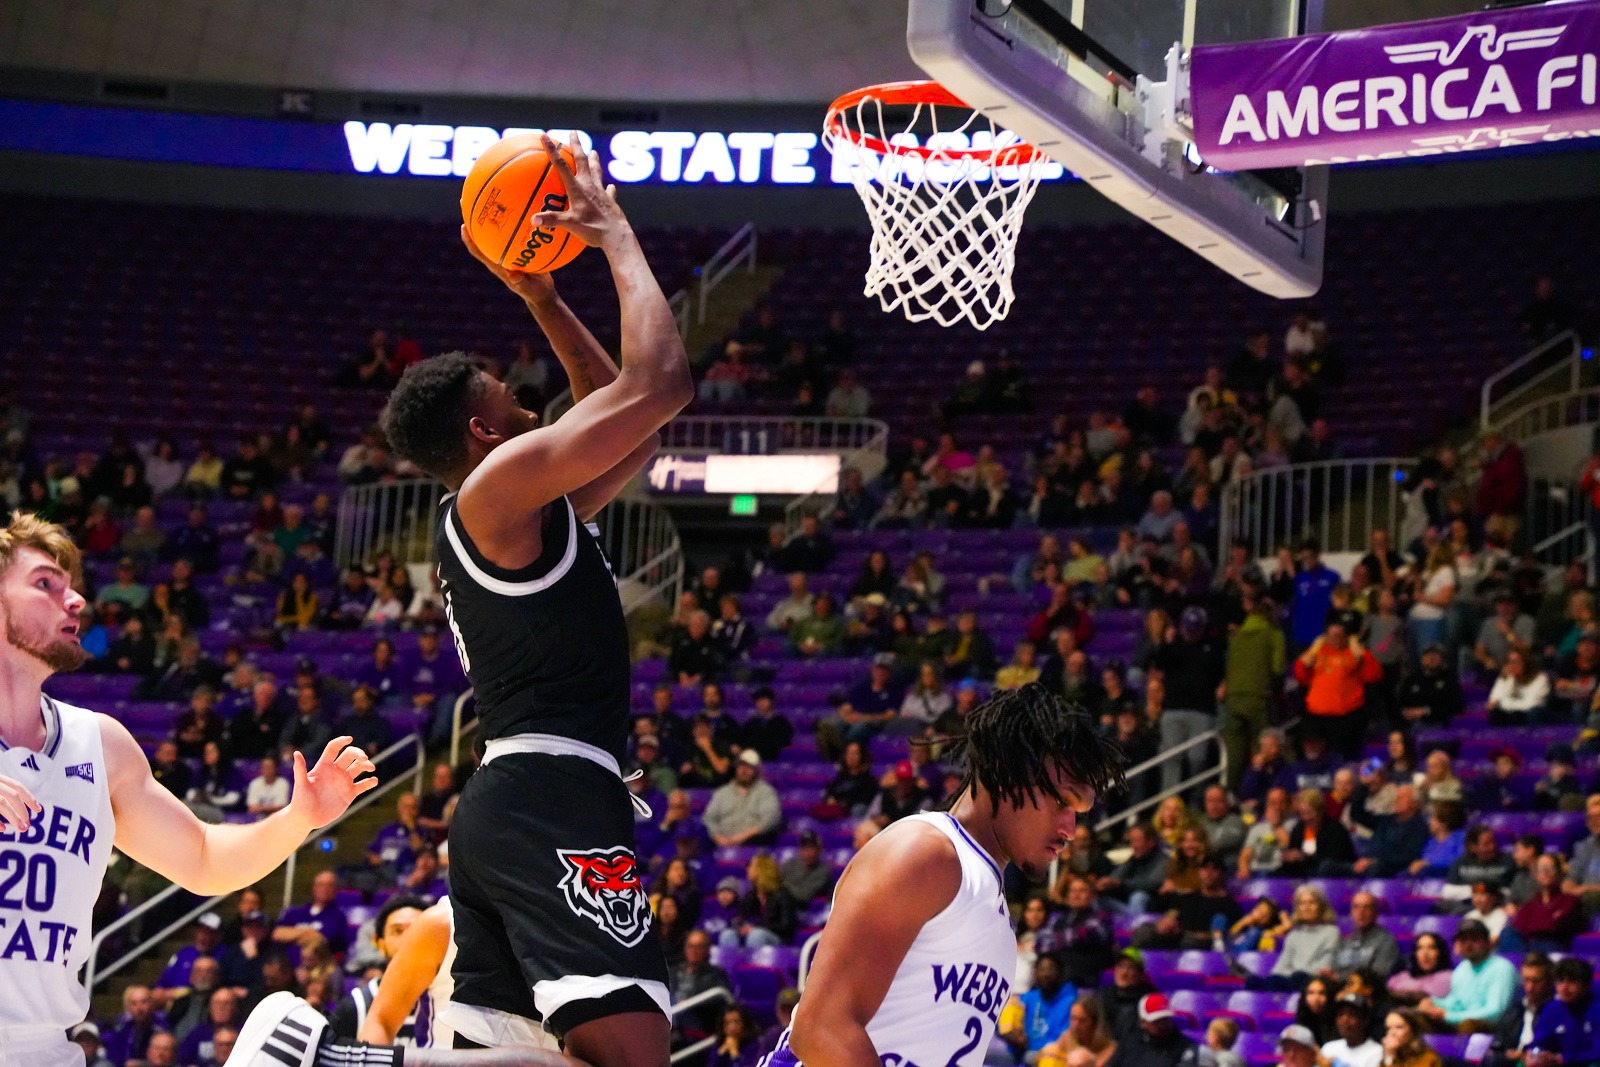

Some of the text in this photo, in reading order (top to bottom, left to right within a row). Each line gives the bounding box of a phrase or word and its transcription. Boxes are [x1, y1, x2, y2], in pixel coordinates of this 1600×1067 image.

[1218, 65, 1521, 145] AMERICA
[344, 120, 592, 177] WEB
[608, 130, 817, 183] STATE
[512, 193, 568, 268] Wlson
[0, 849, 57, 912] 20
[0, 918, 78, 967] ATE
[945, 1016, 982, 1067] 2
